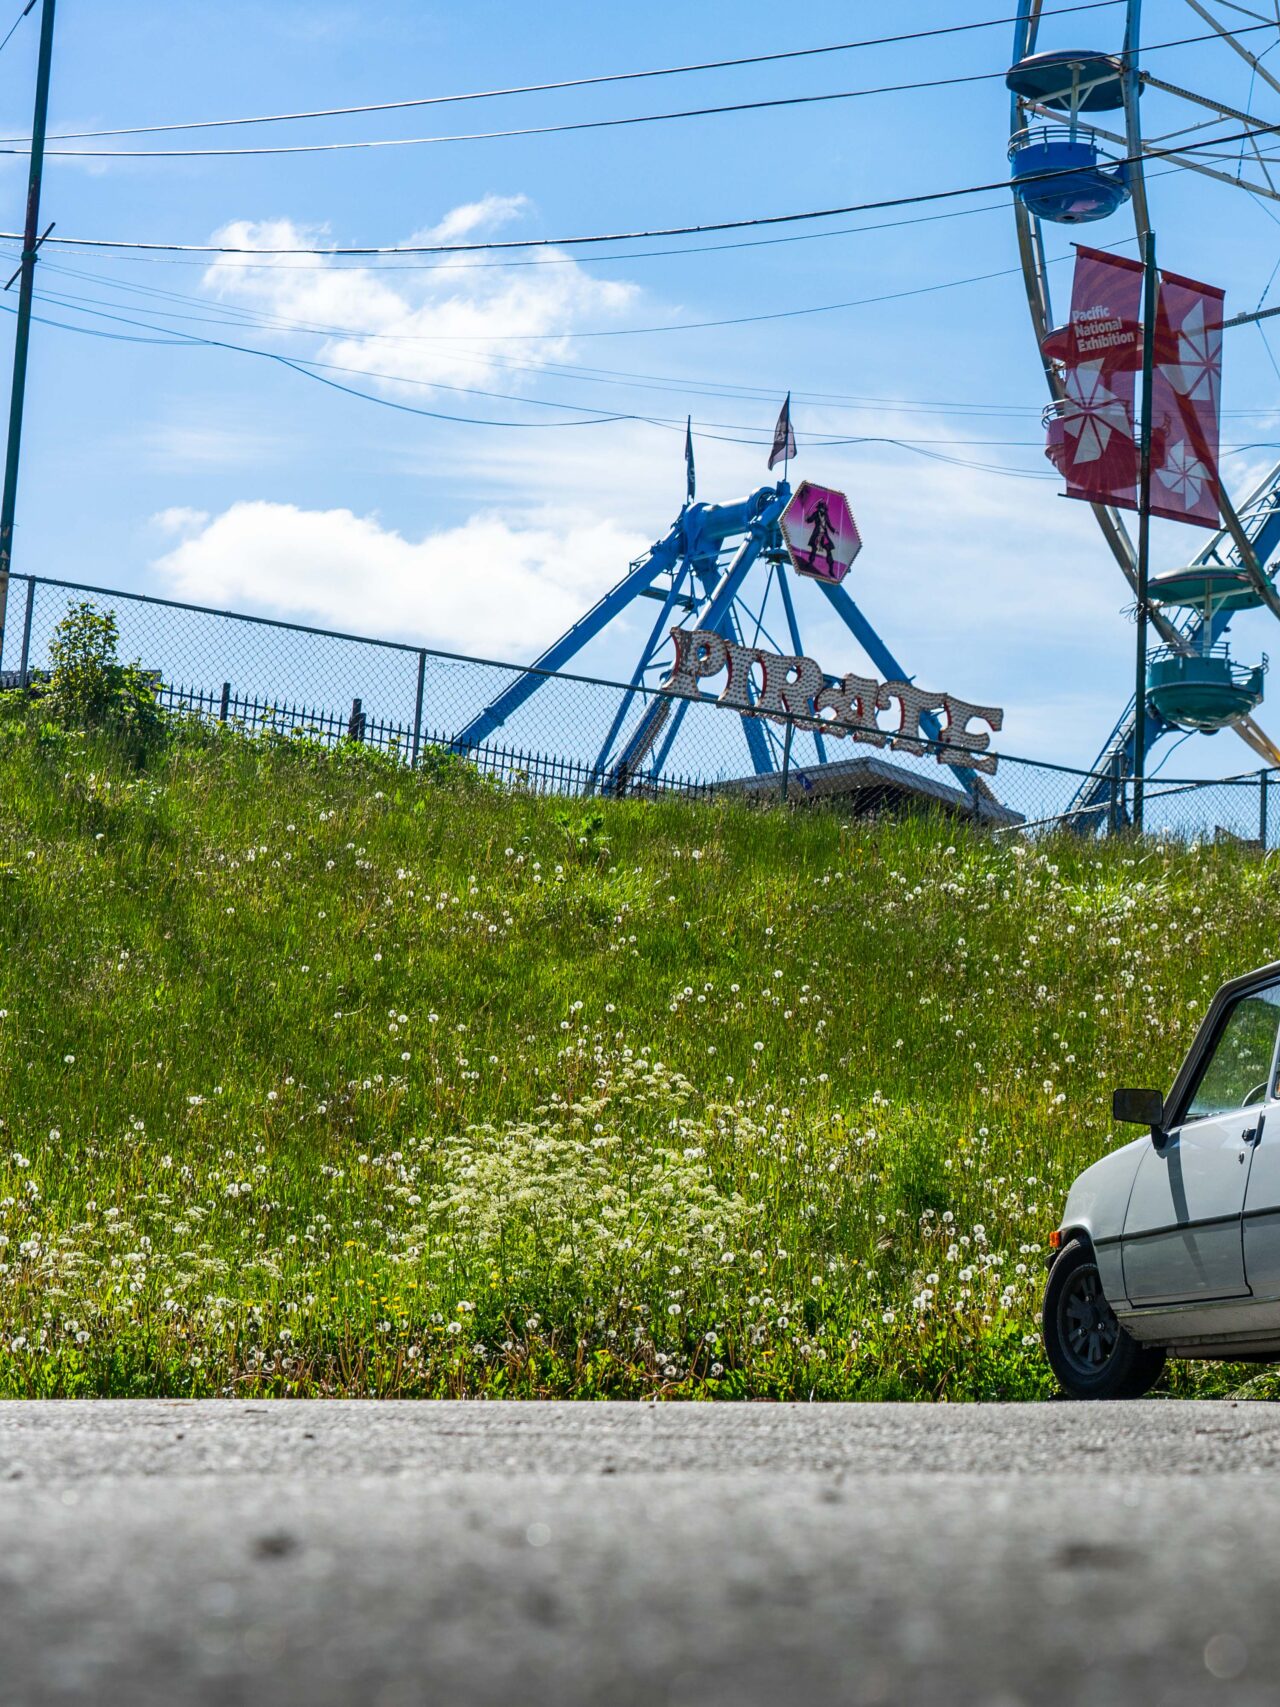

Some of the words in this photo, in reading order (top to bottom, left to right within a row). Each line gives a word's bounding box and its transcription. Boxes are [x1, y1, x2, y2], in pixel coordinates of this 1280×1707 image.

[1072, 305, 1110, 323] Pacific
[1074, 317, 1123, 338] National
[1077, 331, 1135, 353] Exhibition
